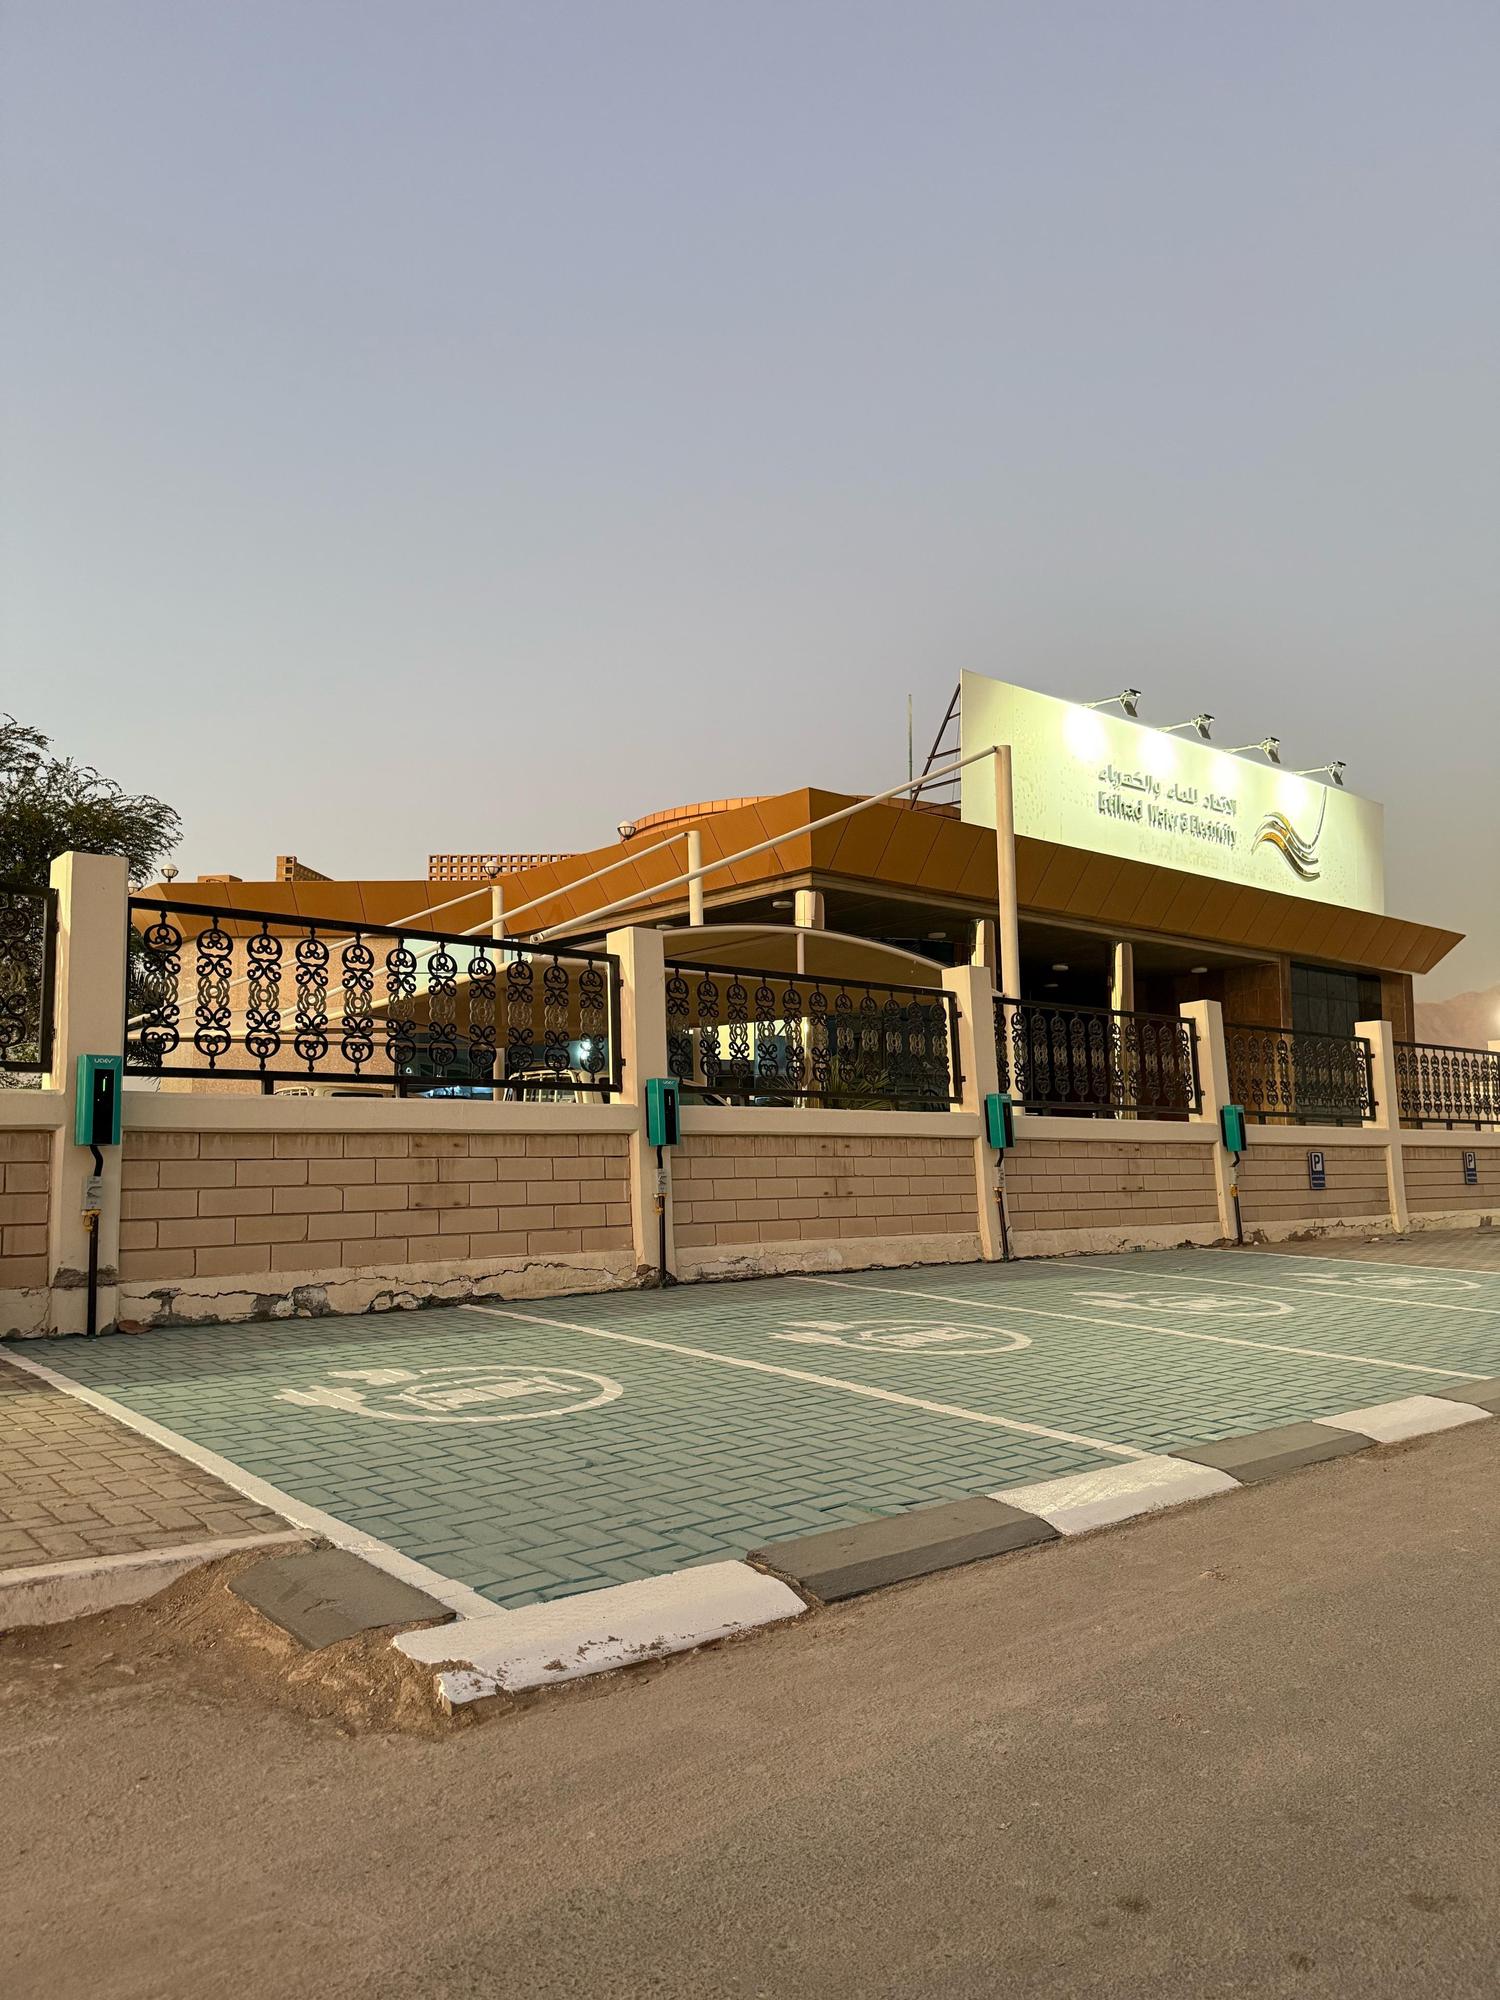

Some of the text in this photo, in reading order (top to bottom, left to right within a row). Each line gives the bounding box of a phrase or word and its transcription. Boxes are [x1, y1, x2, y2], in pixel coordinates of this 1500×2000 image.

[1098, 790, 1144, 823] Etihad
[1147, 803, 1179, 833] Water
[1190, 815, 1238, 850] Electricity
[1313, 1154, 1321, 1170] P
[1467, 1153, 1473, 1167] P
